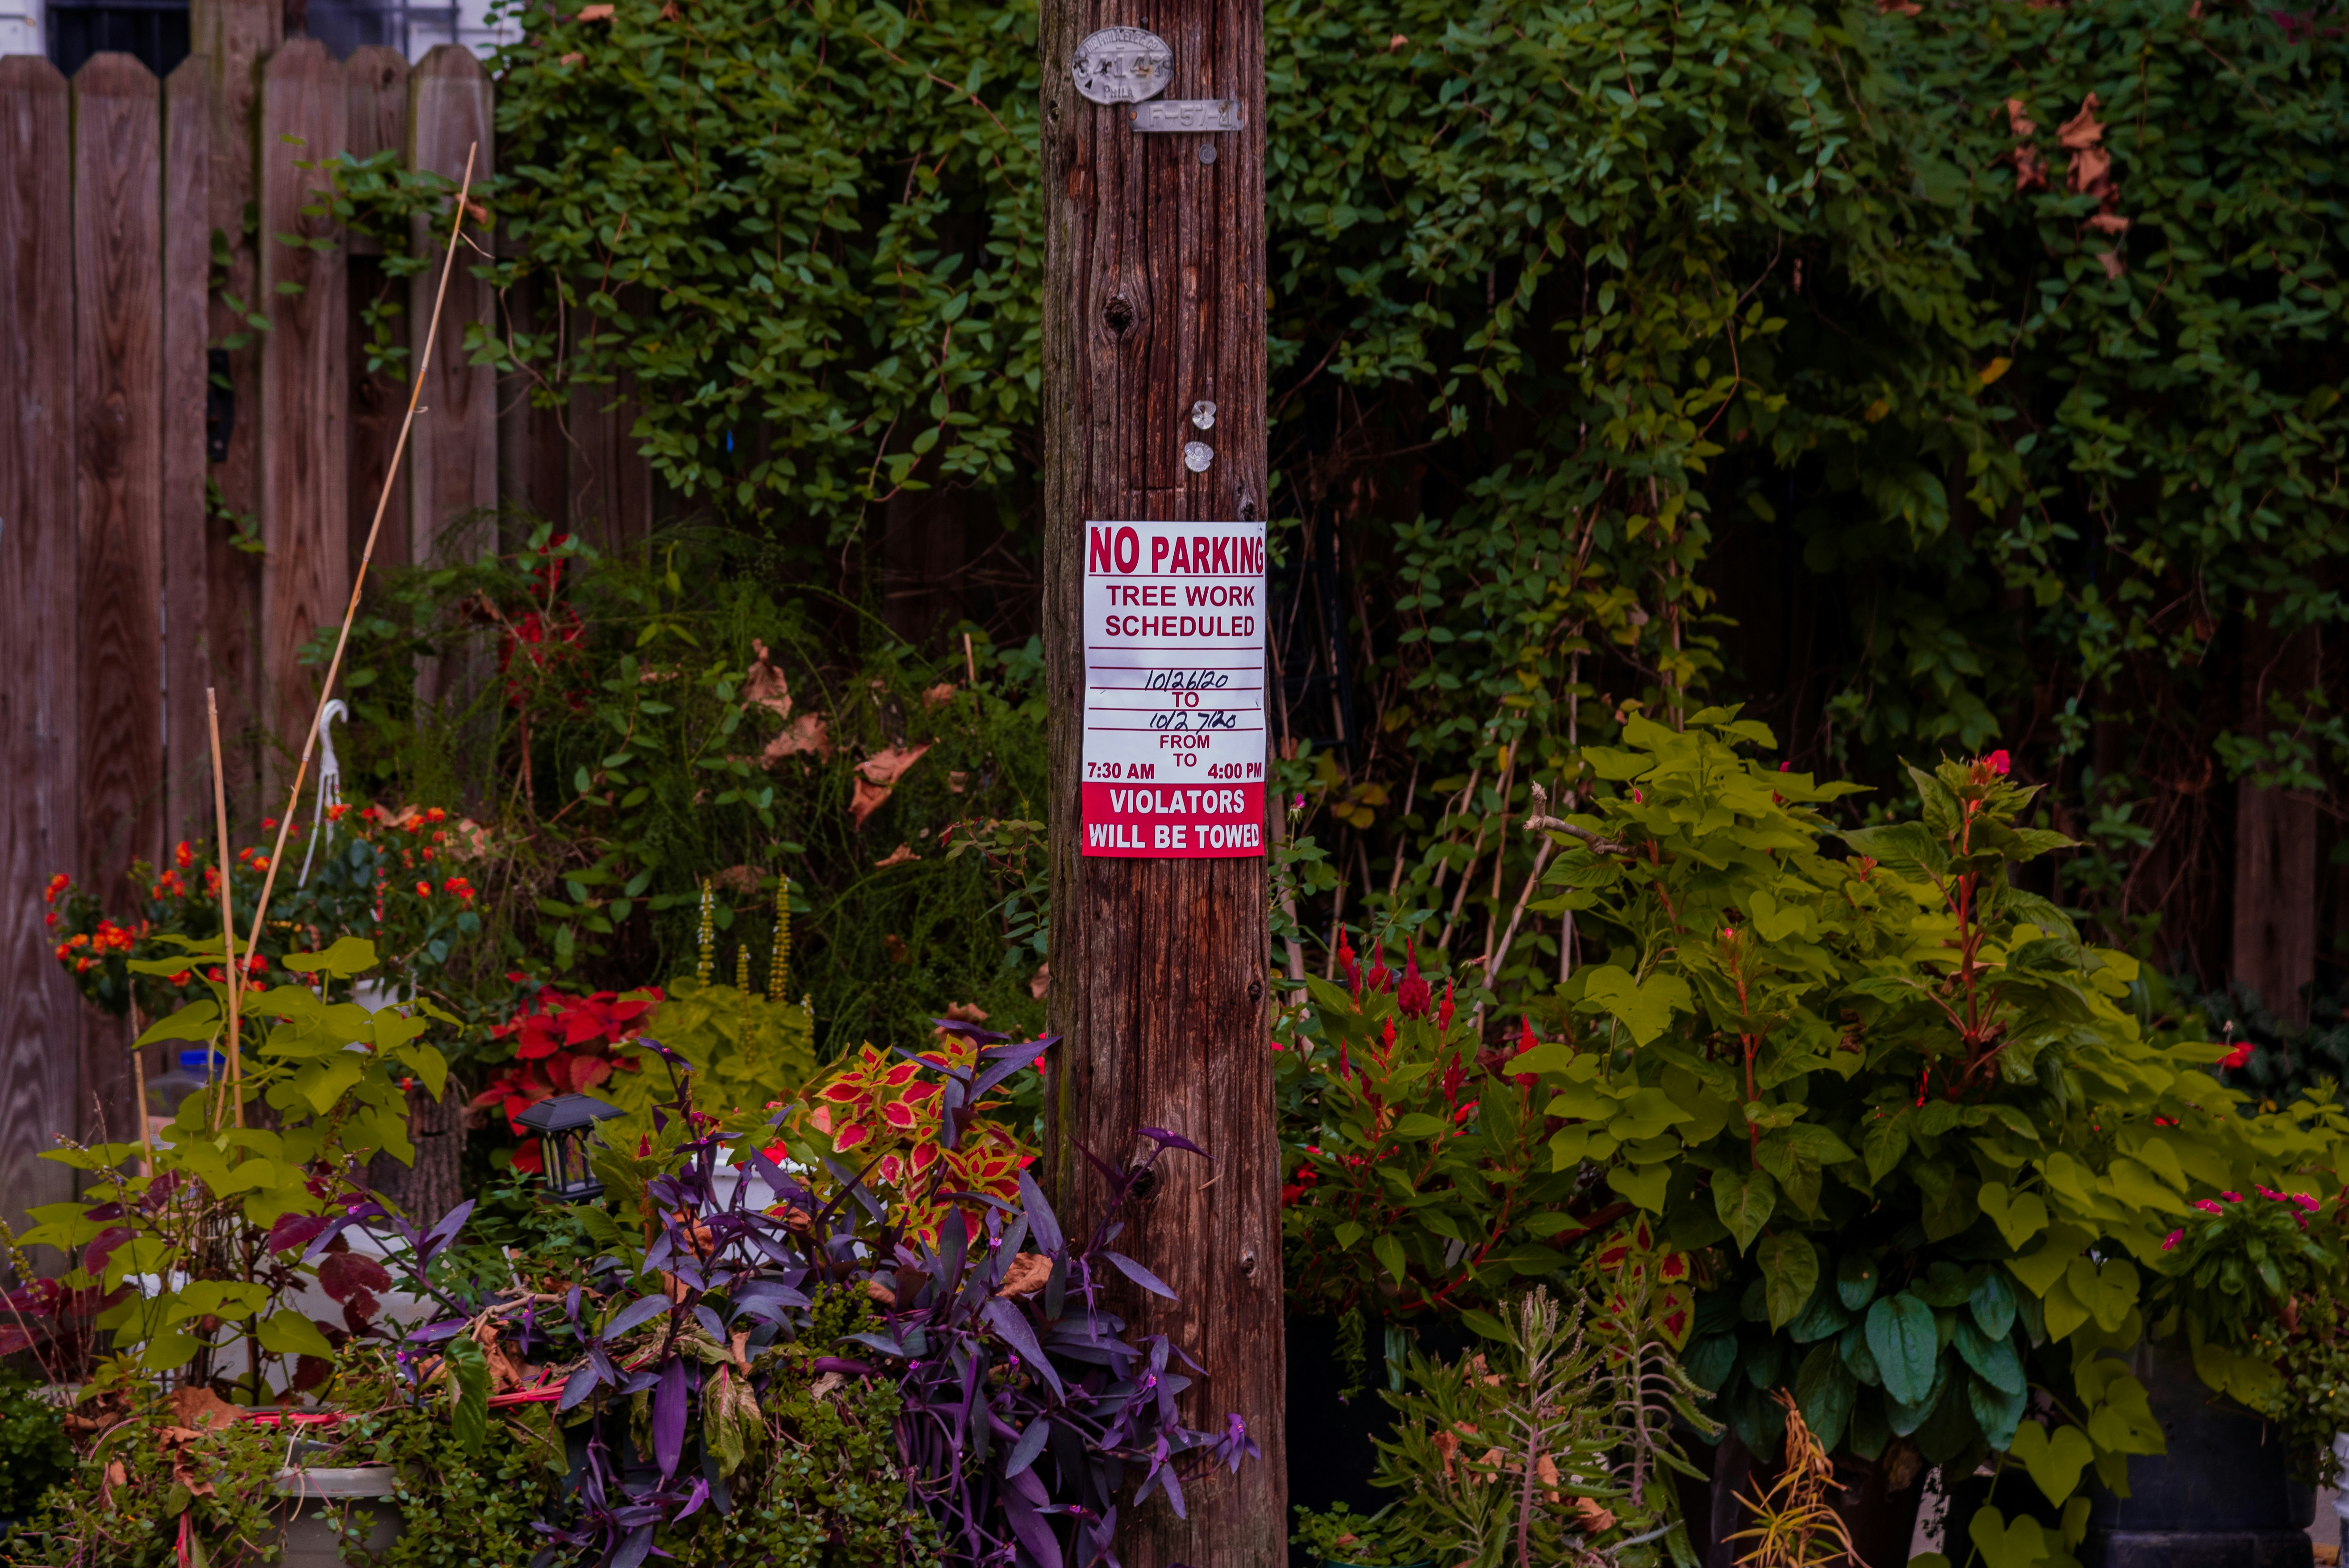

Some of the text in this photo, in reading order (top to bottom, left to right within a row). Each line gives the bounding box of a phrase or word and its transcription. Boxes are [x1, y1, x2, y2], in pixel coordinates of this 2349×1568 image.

[1089, 526, 1264, 574] NO PARKING
[1106, 586, 1255, 606] TREE WORK
[1106, 615, 1254, 637] SCHEDULED
[1145, 668, 1228, 691] 10/26/20
[1172, 692, 1199, 707] TO
[1160, 735, 1210, 749] FROM
[1173, 753, 1197, 767] TO
[1088, 763, 1155, 779] 7:30 AM
[1208, 763, 1262, 779] 4:00 PM
[1110, 789, 1244, 814] VIOLATORS
[1089, 824, 1259, 849] WILL BE TOWED
